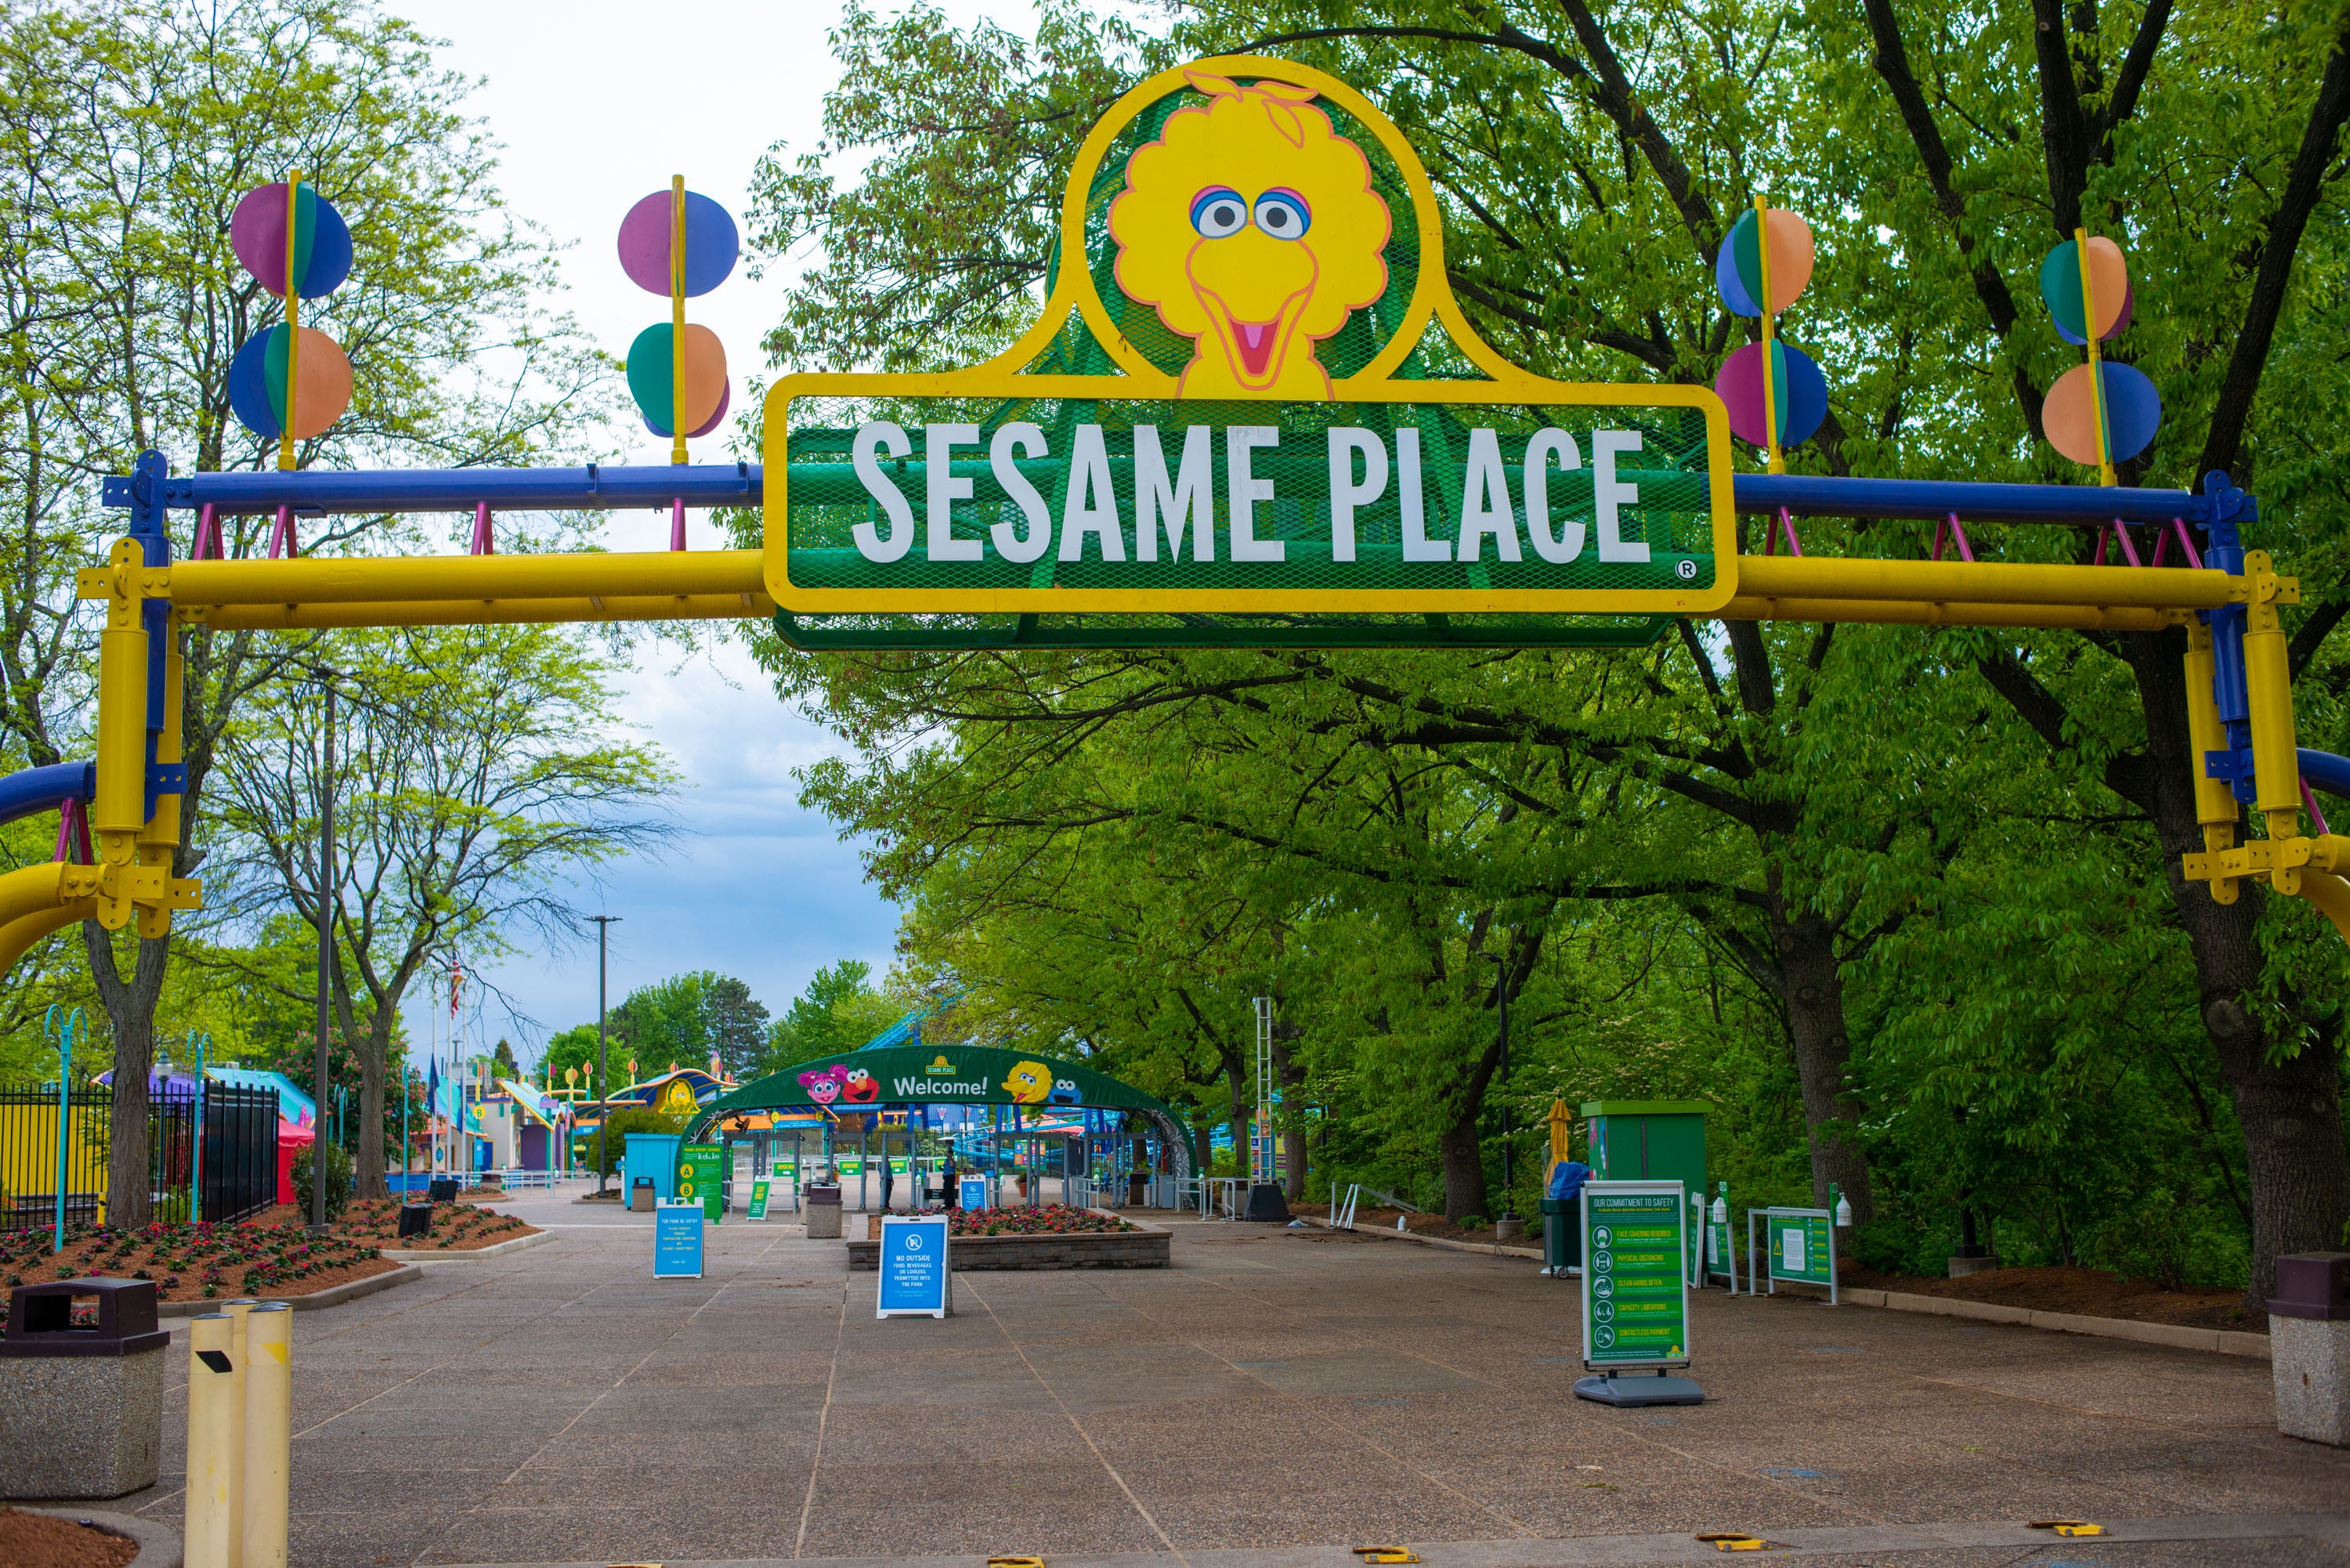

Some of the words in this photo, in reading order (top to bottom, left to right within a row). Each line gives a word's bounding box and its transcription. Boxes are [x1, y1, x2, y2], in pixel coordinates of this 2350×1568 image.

[851, 421, 1285, 565] SESAME
[1328, 425, 1650, 565] PLACE
[893, 1076, 988, 1097] Welcome!
[683, 1167, 690, 1176] A
[684, 1186, 690, 1195] B
[1594, 1198, 1605, 1207] OUR
[1606, 1198, 1643, 1207] COMMITMENT
[1644, 1198, 1651, 1207] TO
[1653, 1198, 1673, 1206] SAFETY
